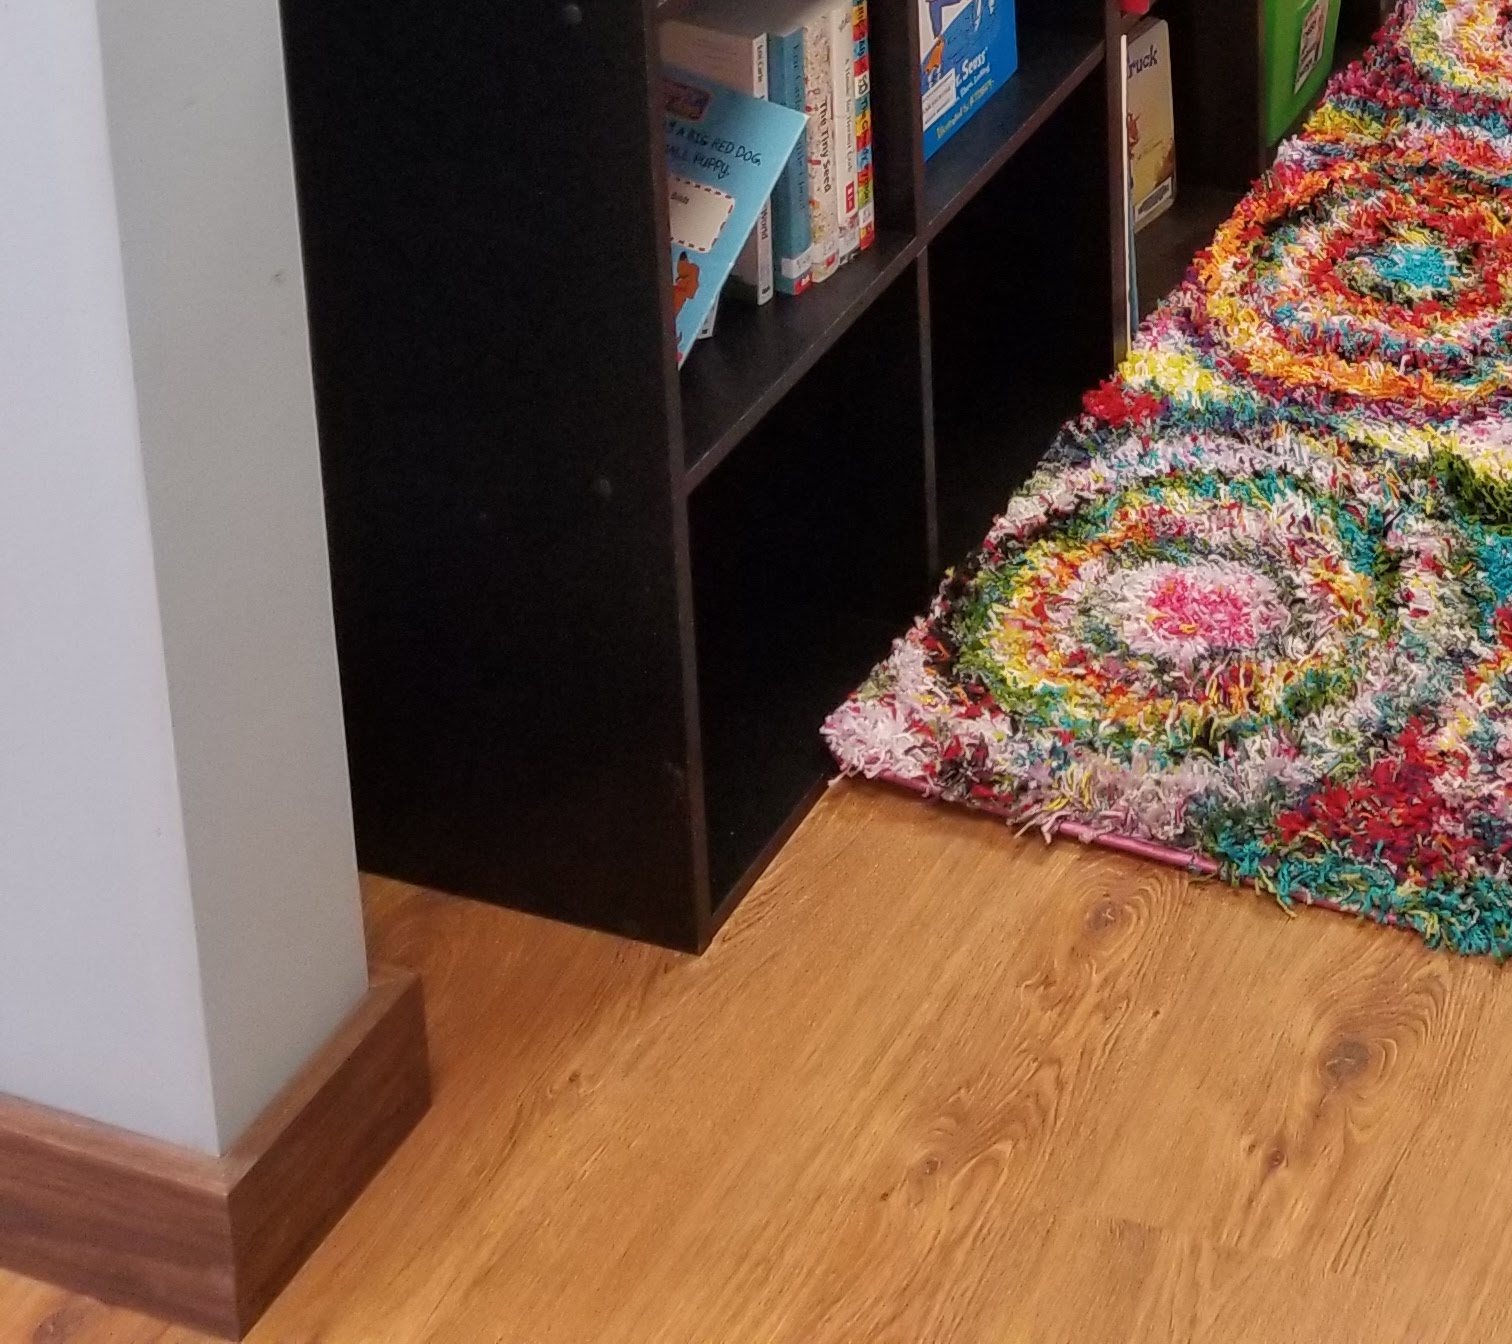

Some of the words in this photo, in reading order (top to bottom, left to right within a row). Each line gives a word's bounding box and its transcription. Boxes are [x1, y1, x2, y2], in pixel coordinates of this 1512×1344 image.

[1127, 44, 1158, 80] ruck
[819, 99, 828, 128] The
[712, 136, 733, 155] RED
[735, 143, 762, 167] DOG,
[819, 129, 831, 160] Tiny
[822, 160, 832, 194] Seed
